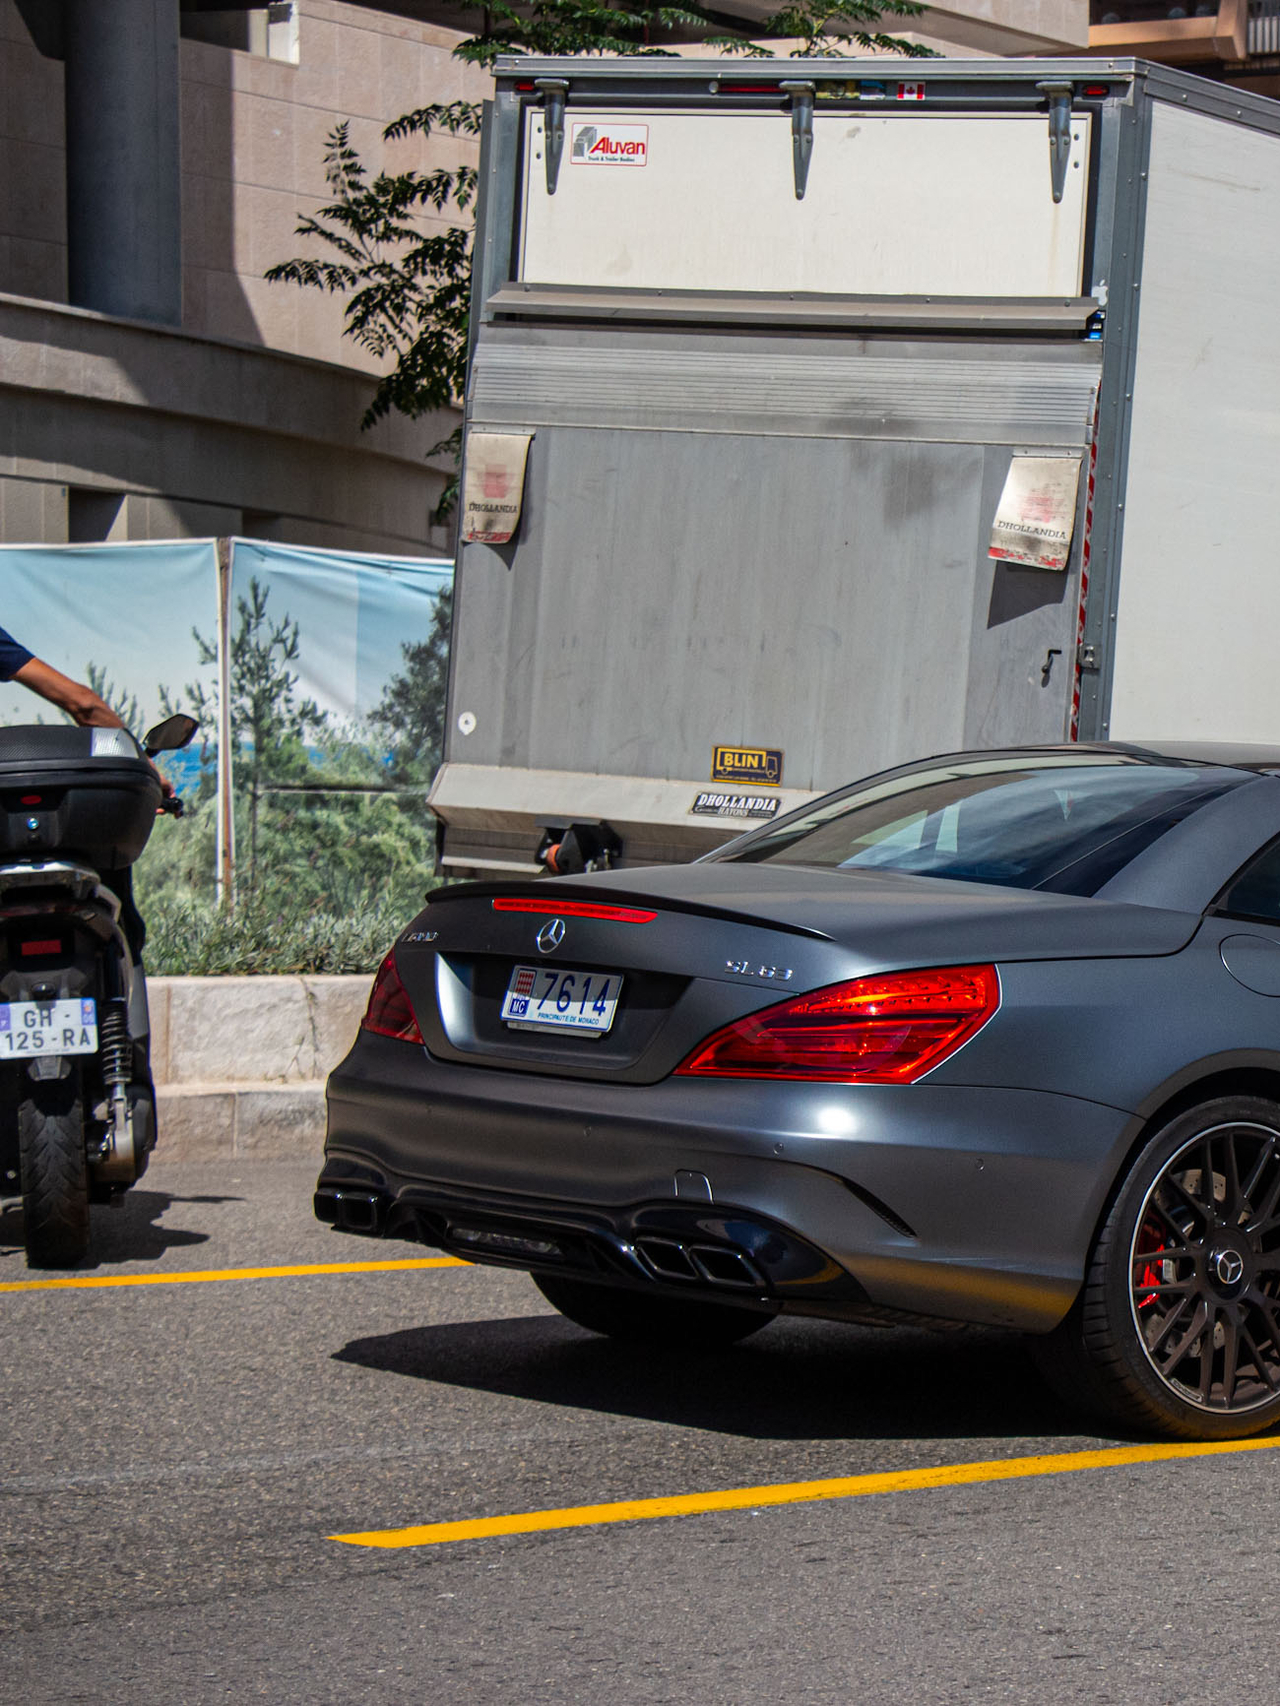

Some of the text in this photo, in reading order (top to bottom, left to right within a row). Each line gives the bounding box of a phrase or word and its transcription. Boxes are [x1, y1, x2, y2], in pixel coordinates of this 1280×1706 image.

[589, 136, 646, 155] Aluvan
[468, 502, 518, 513] DHOLLANDIA
[998, 520, 1067, 540] DHOLLANDIA
[724, 753, 759, 768] BLIN
[697, 793, 777, 811] DHOLLANDIA
[725, 960, 793, 982] SL 63
[537, 971, 611, 1017] 7614
[511, 1000, 525, 1014] MC
[570, 1015, 577, 1023] DE
[578, 1016, 600, 1026] MONACO
